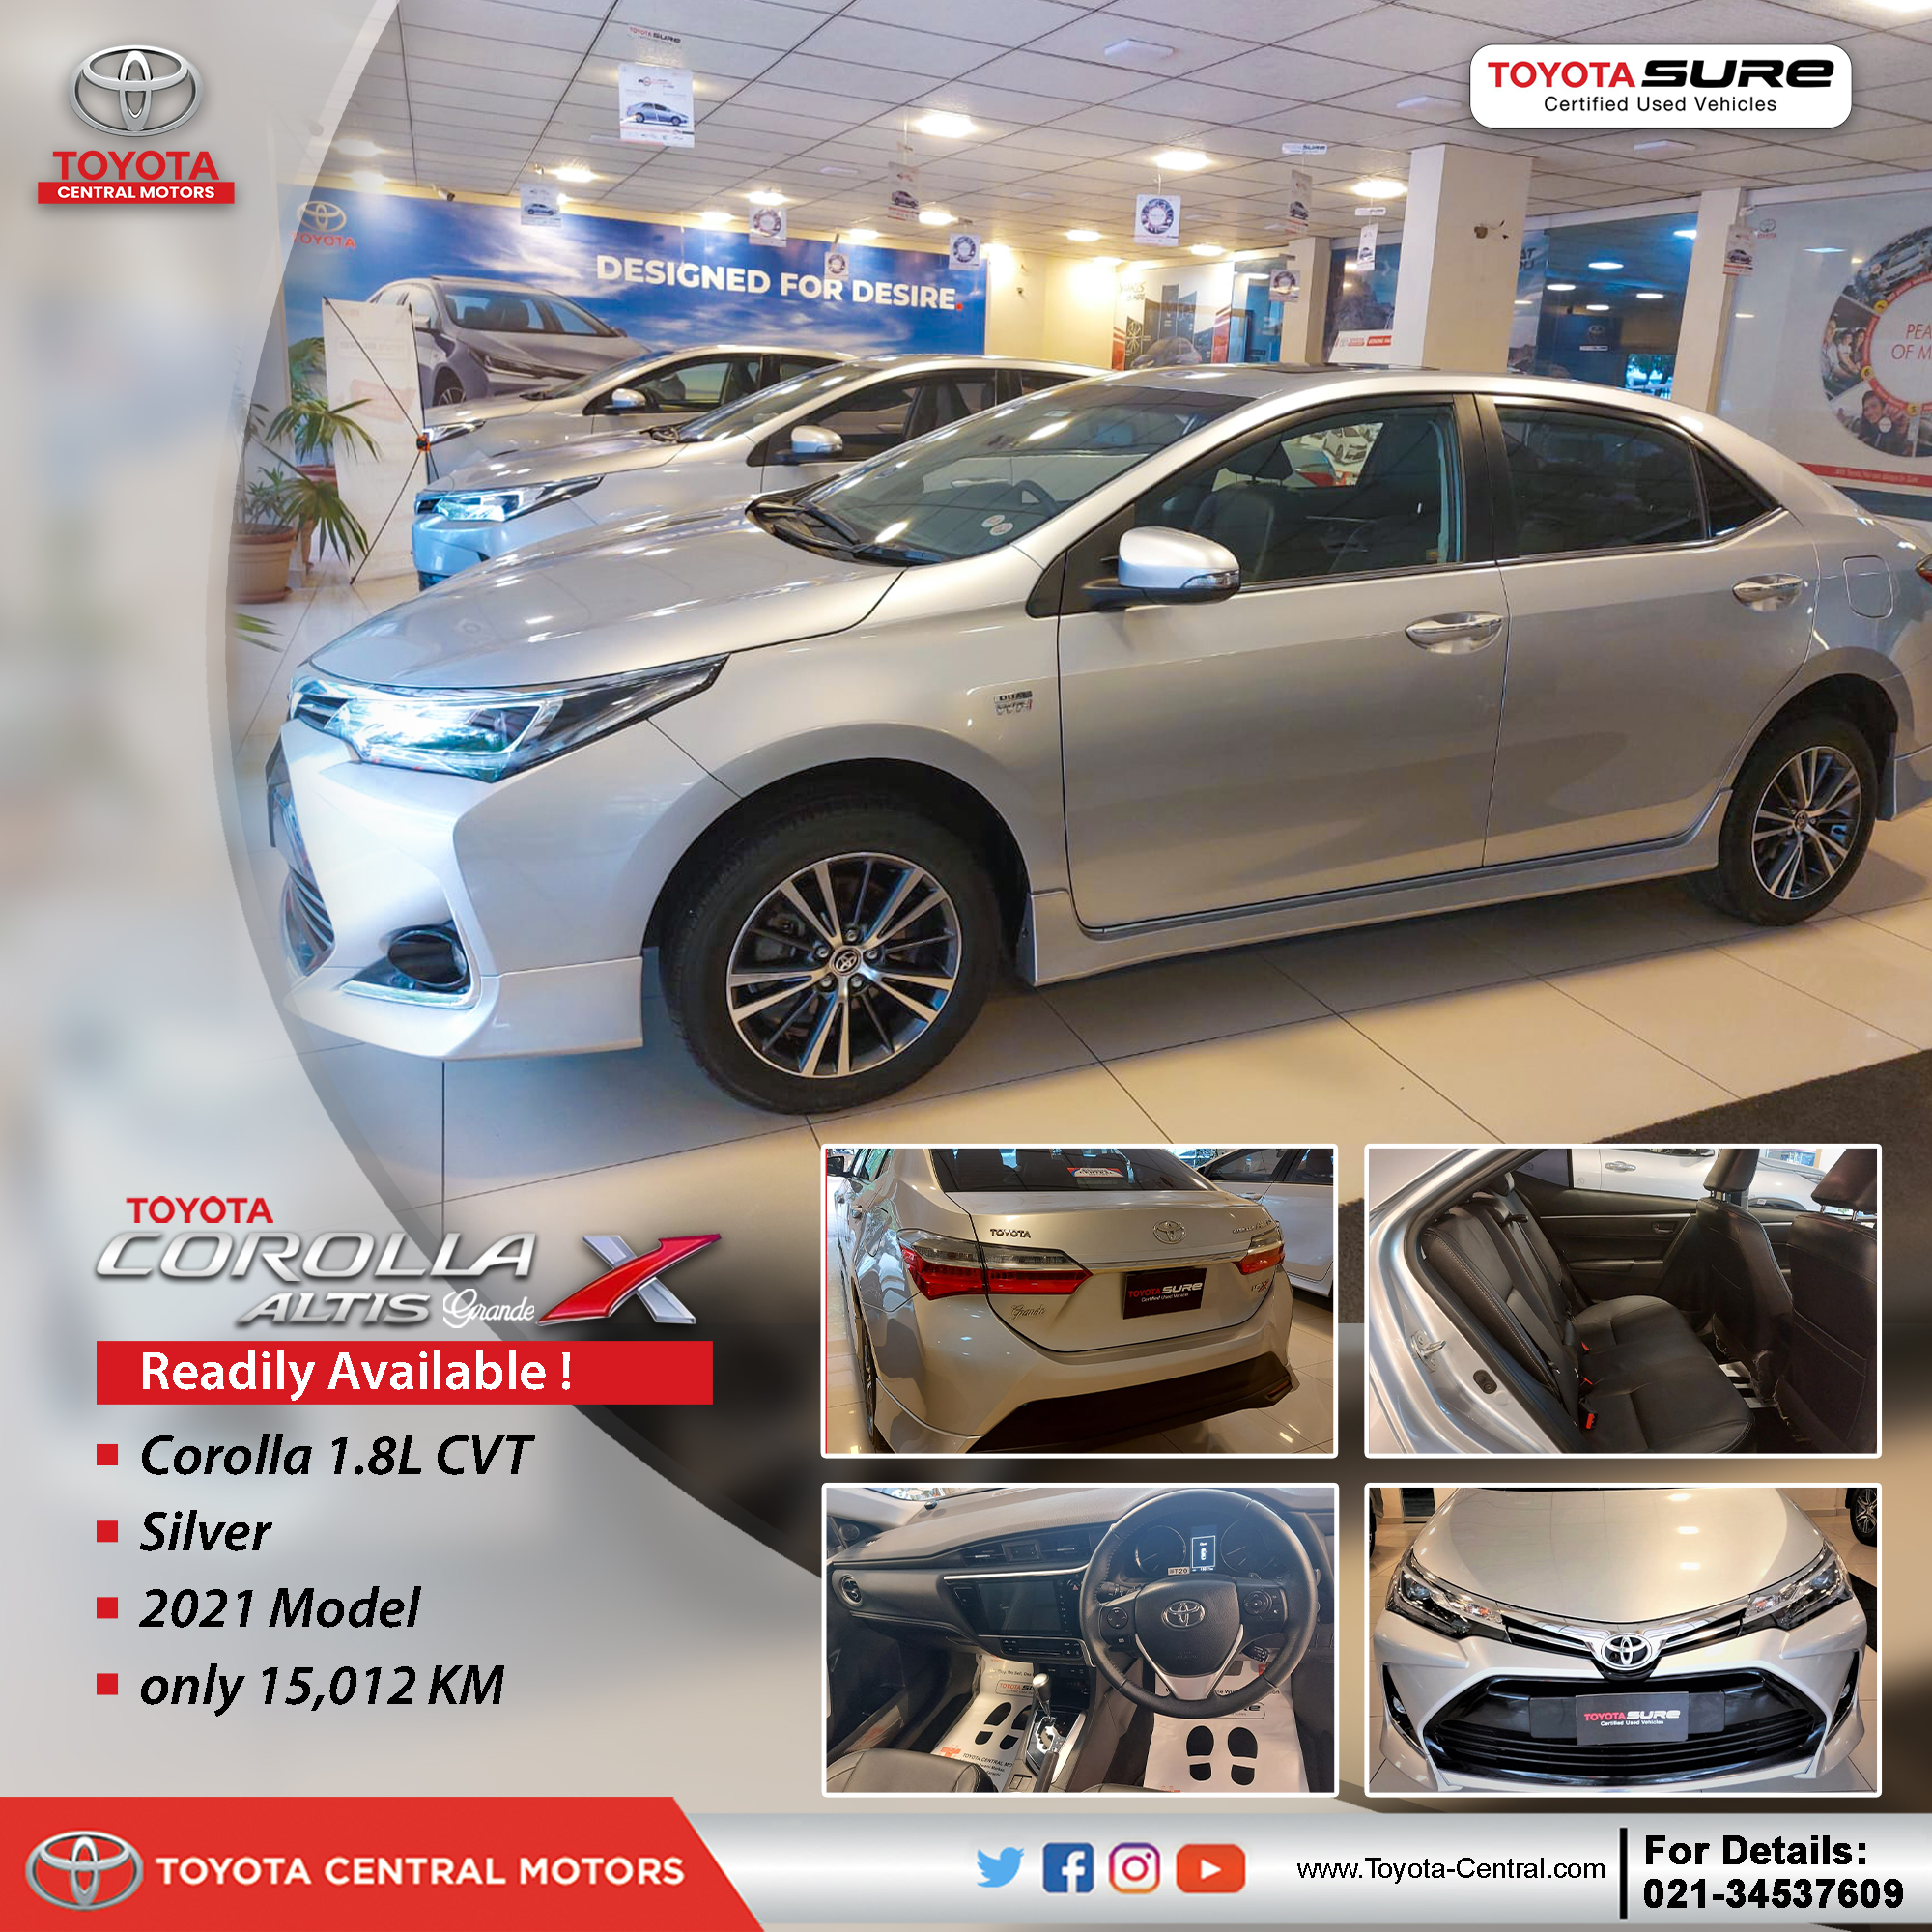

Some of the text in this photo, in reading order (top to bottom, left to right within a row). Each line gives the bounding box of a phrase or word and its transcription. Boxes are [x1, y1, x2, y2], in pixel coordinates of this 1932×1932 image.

[291, 231, 355, 249] TOYOTA
[597, 255, 771, 295] DESIGNED
[781, 272, 843, 301] FOR
[1891, 344, 1915, 360] OF
[990, 1228, 1031, 1238] TOYOTA
[1128, 1288, 1161, 1297] TOYOTA
[1584, 1710, 1681, 1721] TOYOTA SURE
[963, 1752, 980, 1761] TOYOTA
[980, 1756, 1003, 1767] CENTRAL
